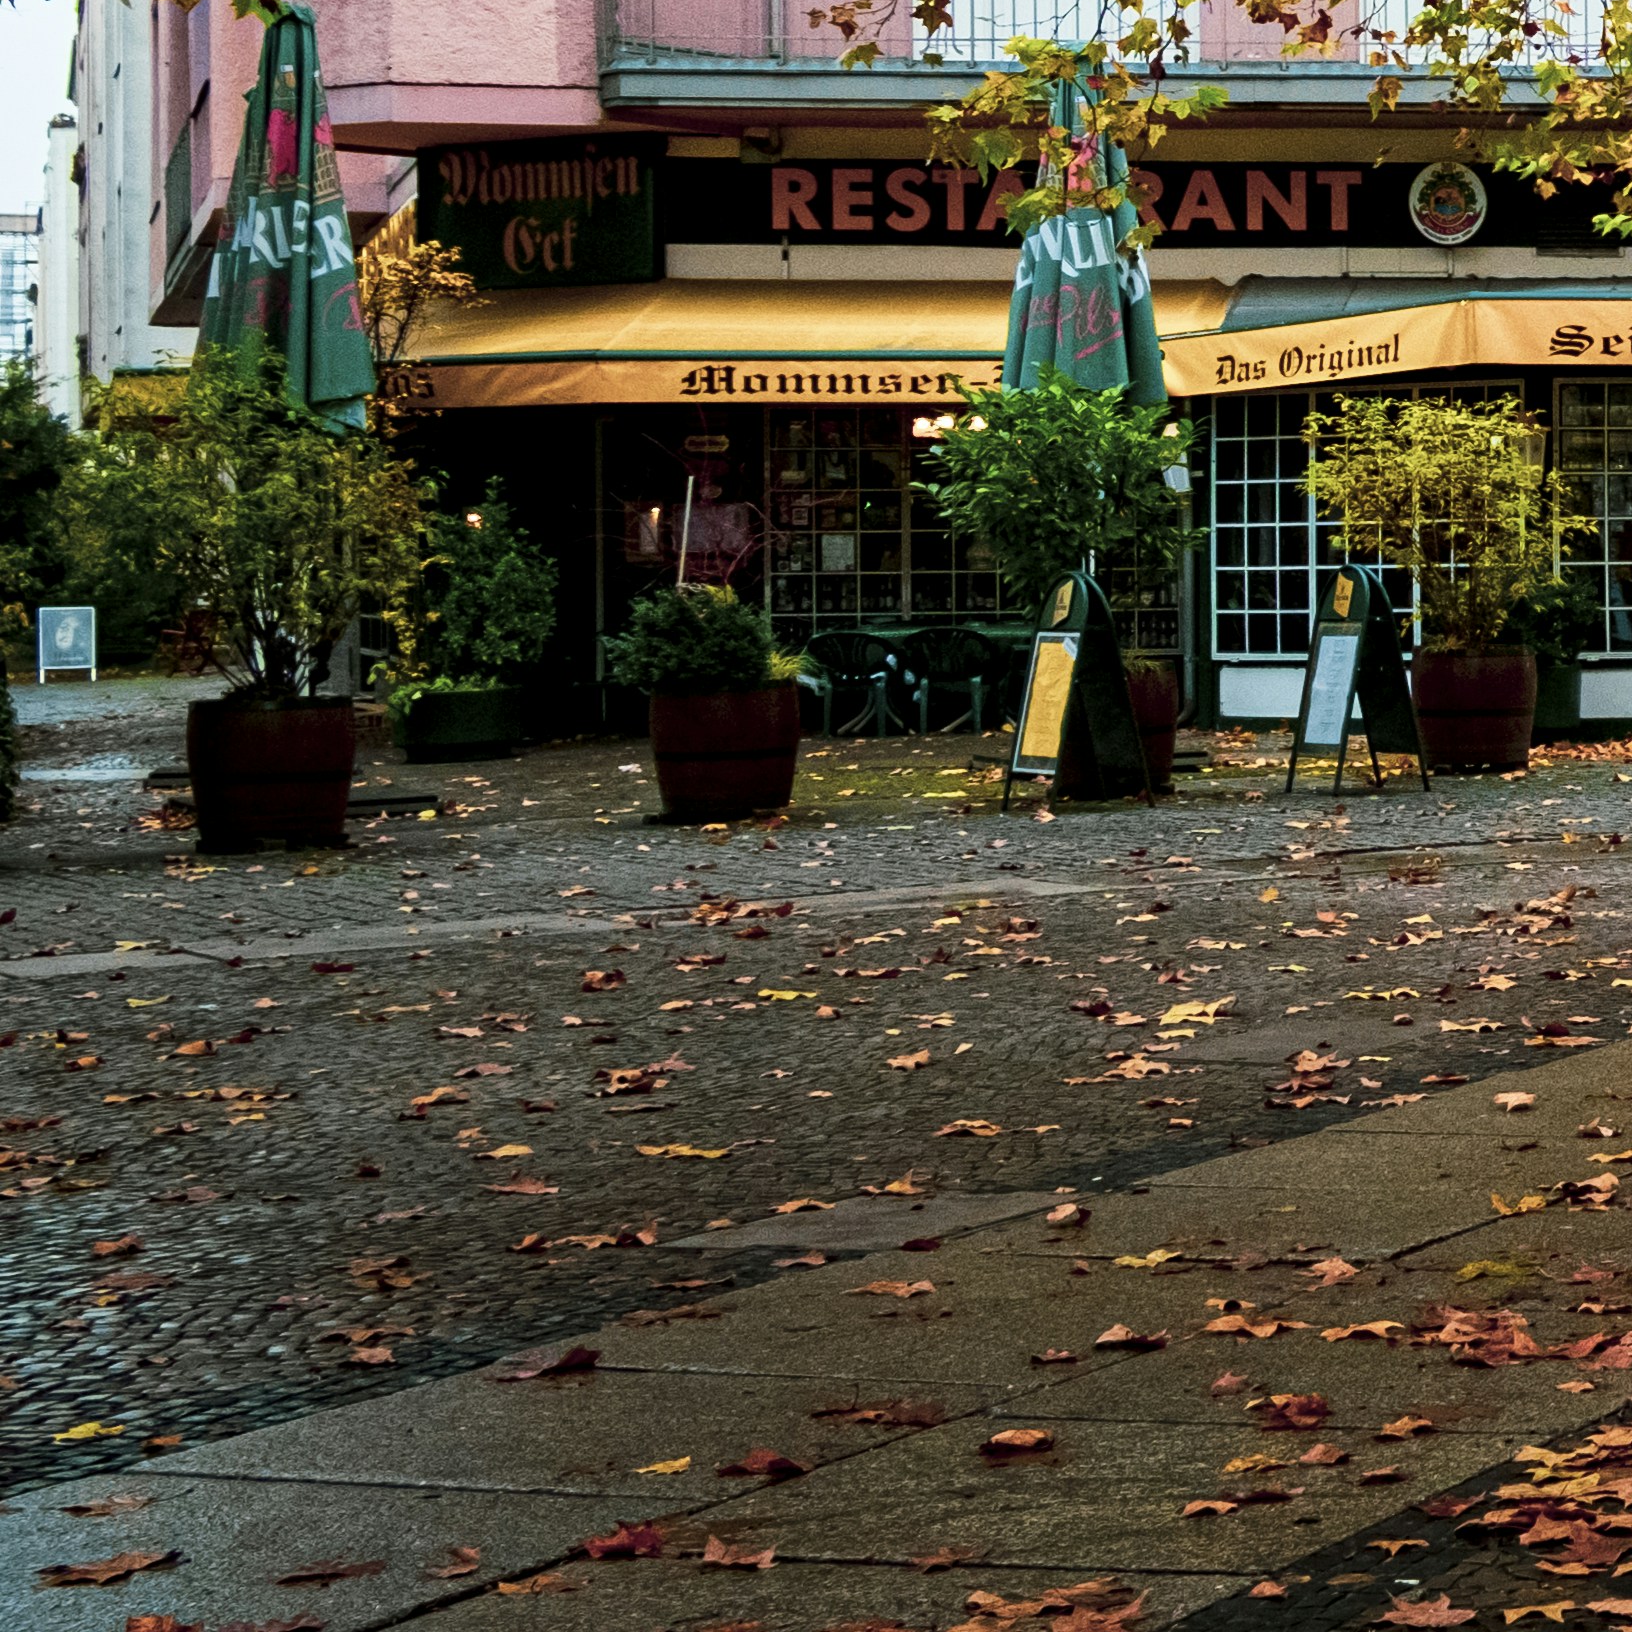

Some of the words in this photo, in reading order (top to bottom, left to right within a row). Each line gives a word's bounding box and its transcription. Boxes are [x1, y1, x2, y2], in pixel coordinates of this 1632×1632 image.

[771, 167, 1362, 232] RESTARANT
[1216, 344, 1266, 385] Das
[1278, 332, 1400, 377] Original
